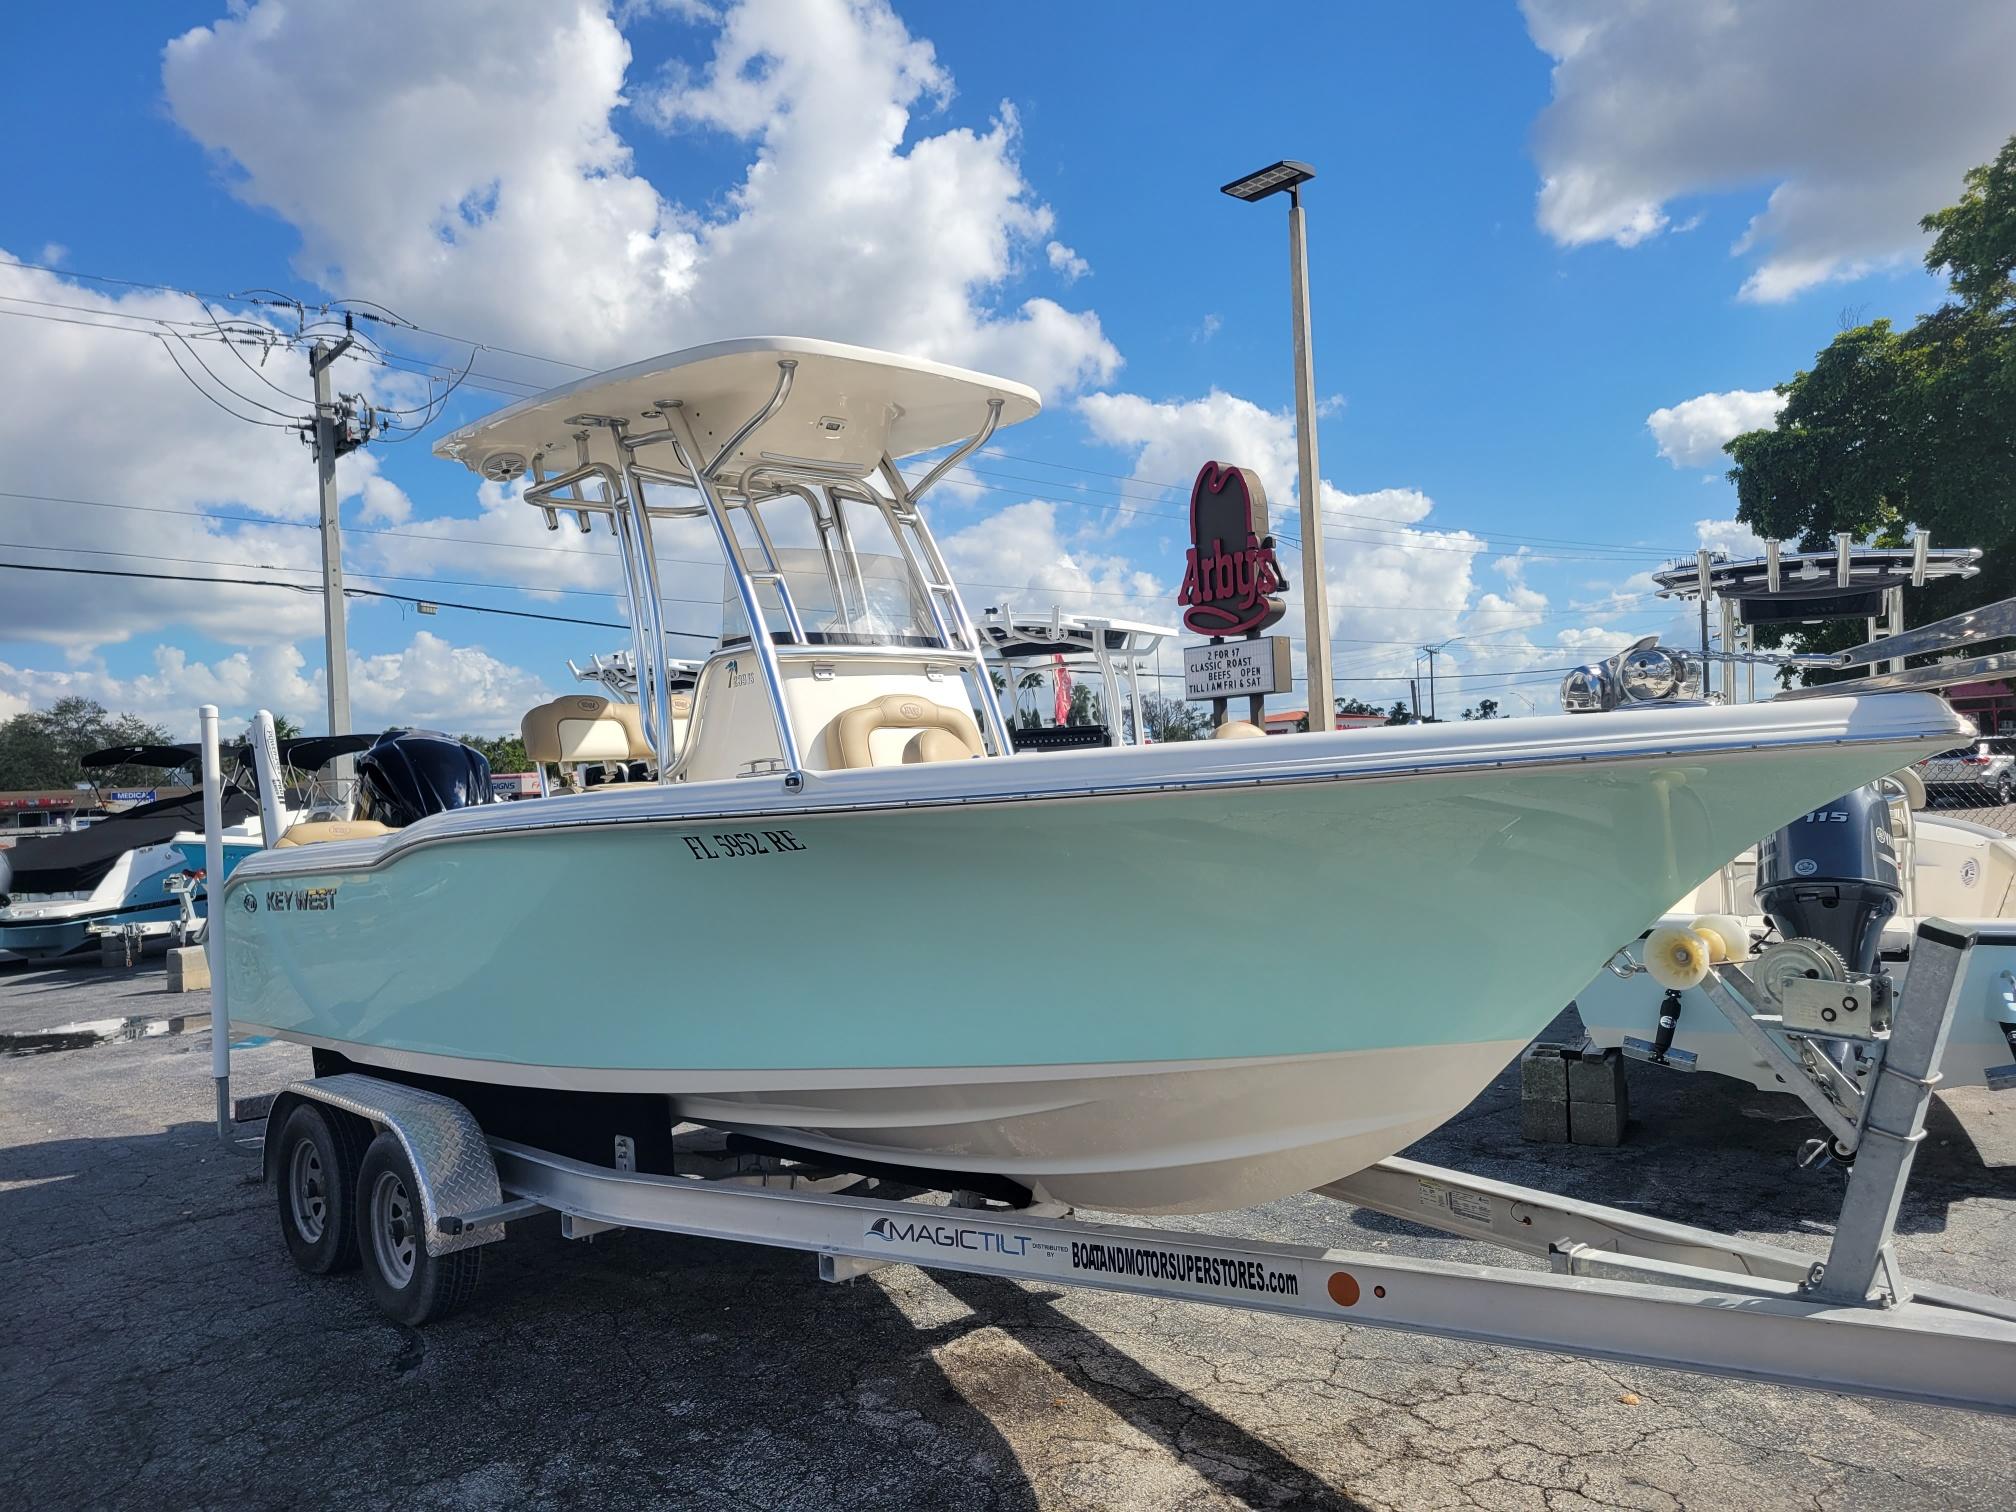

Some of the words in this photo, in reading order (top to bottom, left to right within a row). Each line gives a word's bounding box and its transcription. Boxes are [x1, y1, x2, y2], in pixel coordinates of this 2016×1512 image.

[1178, 536, 1276, 609] Arby's
[1208, 652, 1212, 660] 2
[1214, 650, 1229, 659] FOR
[1232, 648, 1240, 657] $7
[1190, 661, 1221, 672] CLASSIC
[1226, 657, 1251, 668] ROAST
[1208, 670, 1231, 680] BEEFS
[1240, 667, 1261, 677] OPEN
[1189, 683, 1204, 693] TILL
[1211, 681, 1222, 691] AM
[1224, 680, 1237, 690] FRI
[1246, 677, 1261, 687] SAT
[1805, 811, 1849, 823] 115
[681, 836, 720, 860] FL
[712, 832, 770, 858] 5952
[760, 830, 807, 852] RE
[266, 891, 293, 911] KEY
[295, 888, 337, 911] WEST
[889, 1221, 1032, 1256] MAGICTILT
[1032, 1243, 1068, 1252] DISTRIBUTED
[1071, 1241, 1299, 1296] BOATANDMOTORSUPERSTORES.com
